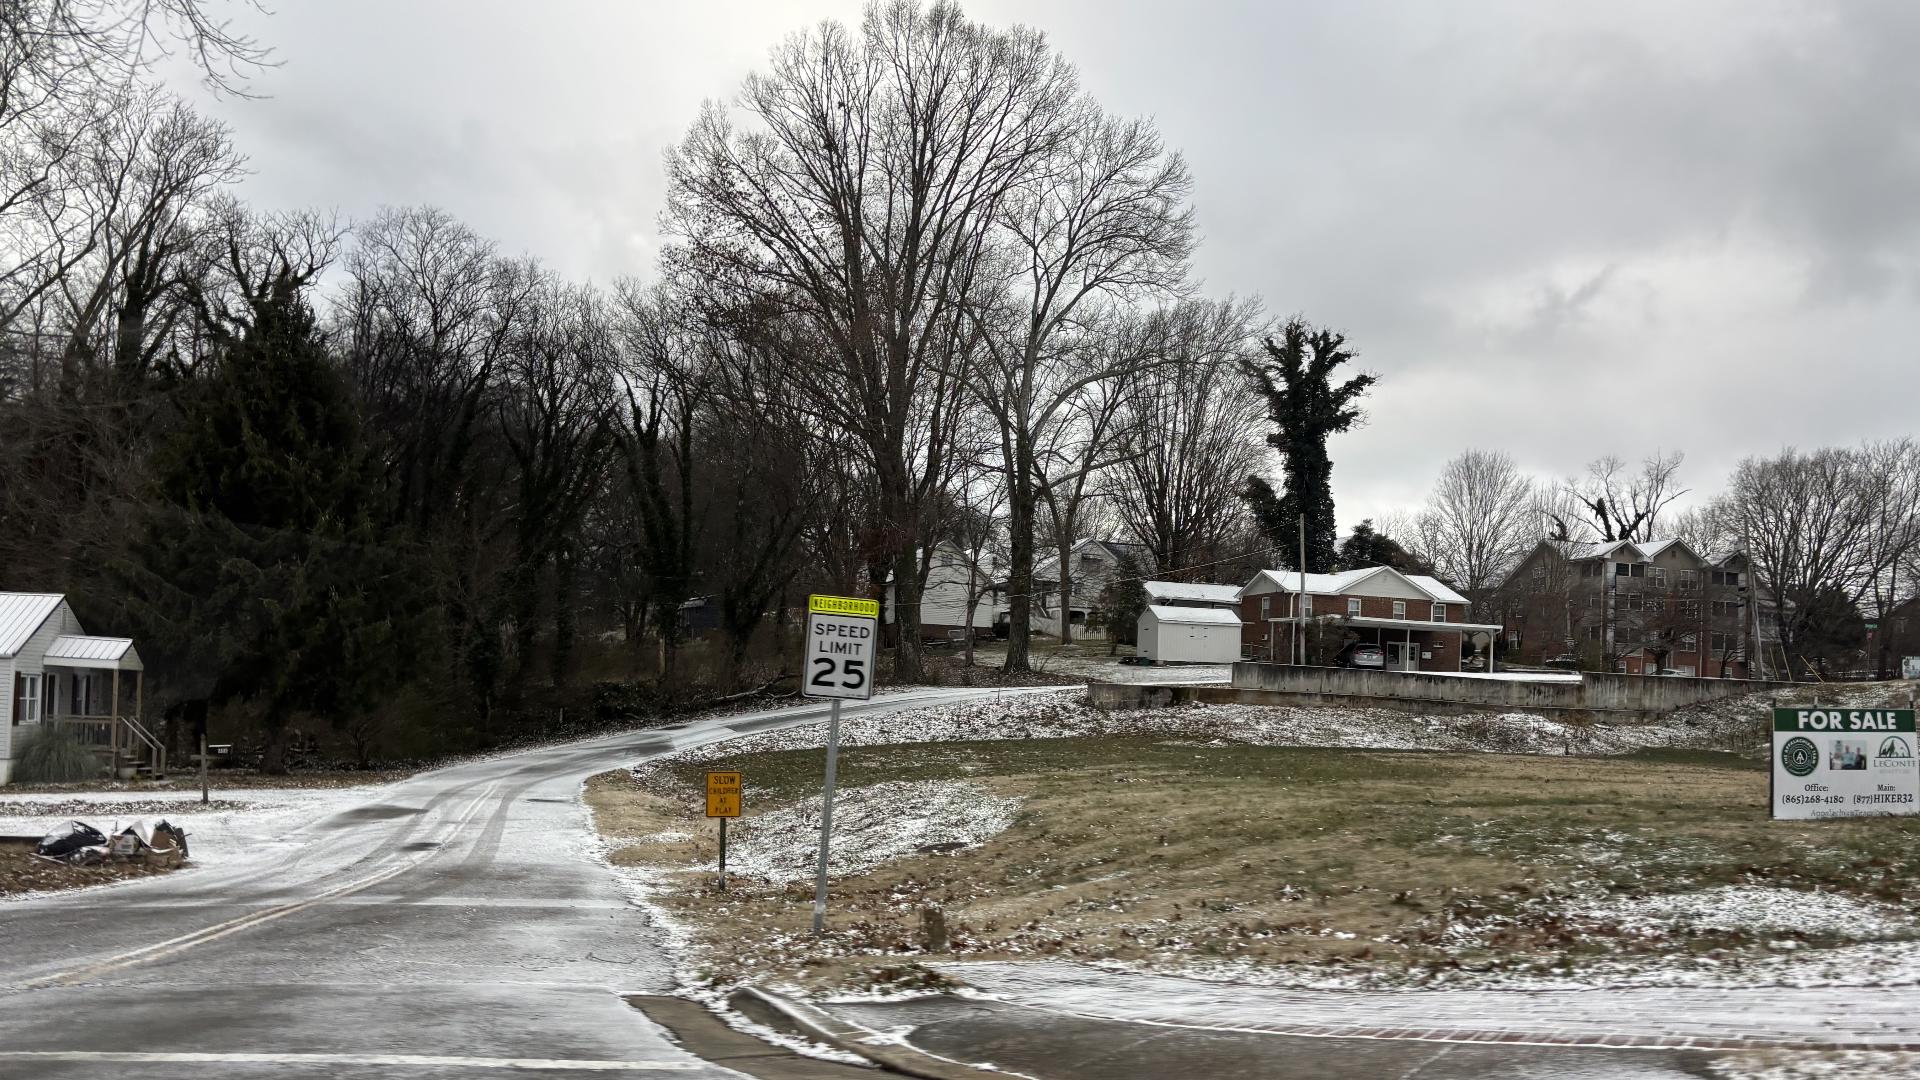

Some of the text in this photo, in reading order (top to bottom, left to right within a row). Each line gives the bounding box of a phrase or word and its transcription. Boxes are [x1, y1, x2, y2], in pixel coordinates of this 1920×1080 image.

[813, 597, 875, 613] NEIGHBORHOOD
[814, 623, 870, 639] SPEED
[819, 640, 863, 656] LIMIT
[811, 657, 865, 690] 25
[1798, 710, 1897, 730] FOR SALE
[713, 775, 736, 785] SLOW
[709, 787, 739, 795] CHILDREN
[1804, 783, 1829, 792] Office:
[1877, 784, 1896, 792] Main:
[1782, 794, 1844, 805] (865)268-4180
[1853, 793, 1914, 805] (877)HIKER32
[715, 806, 732, 814] PLAY
